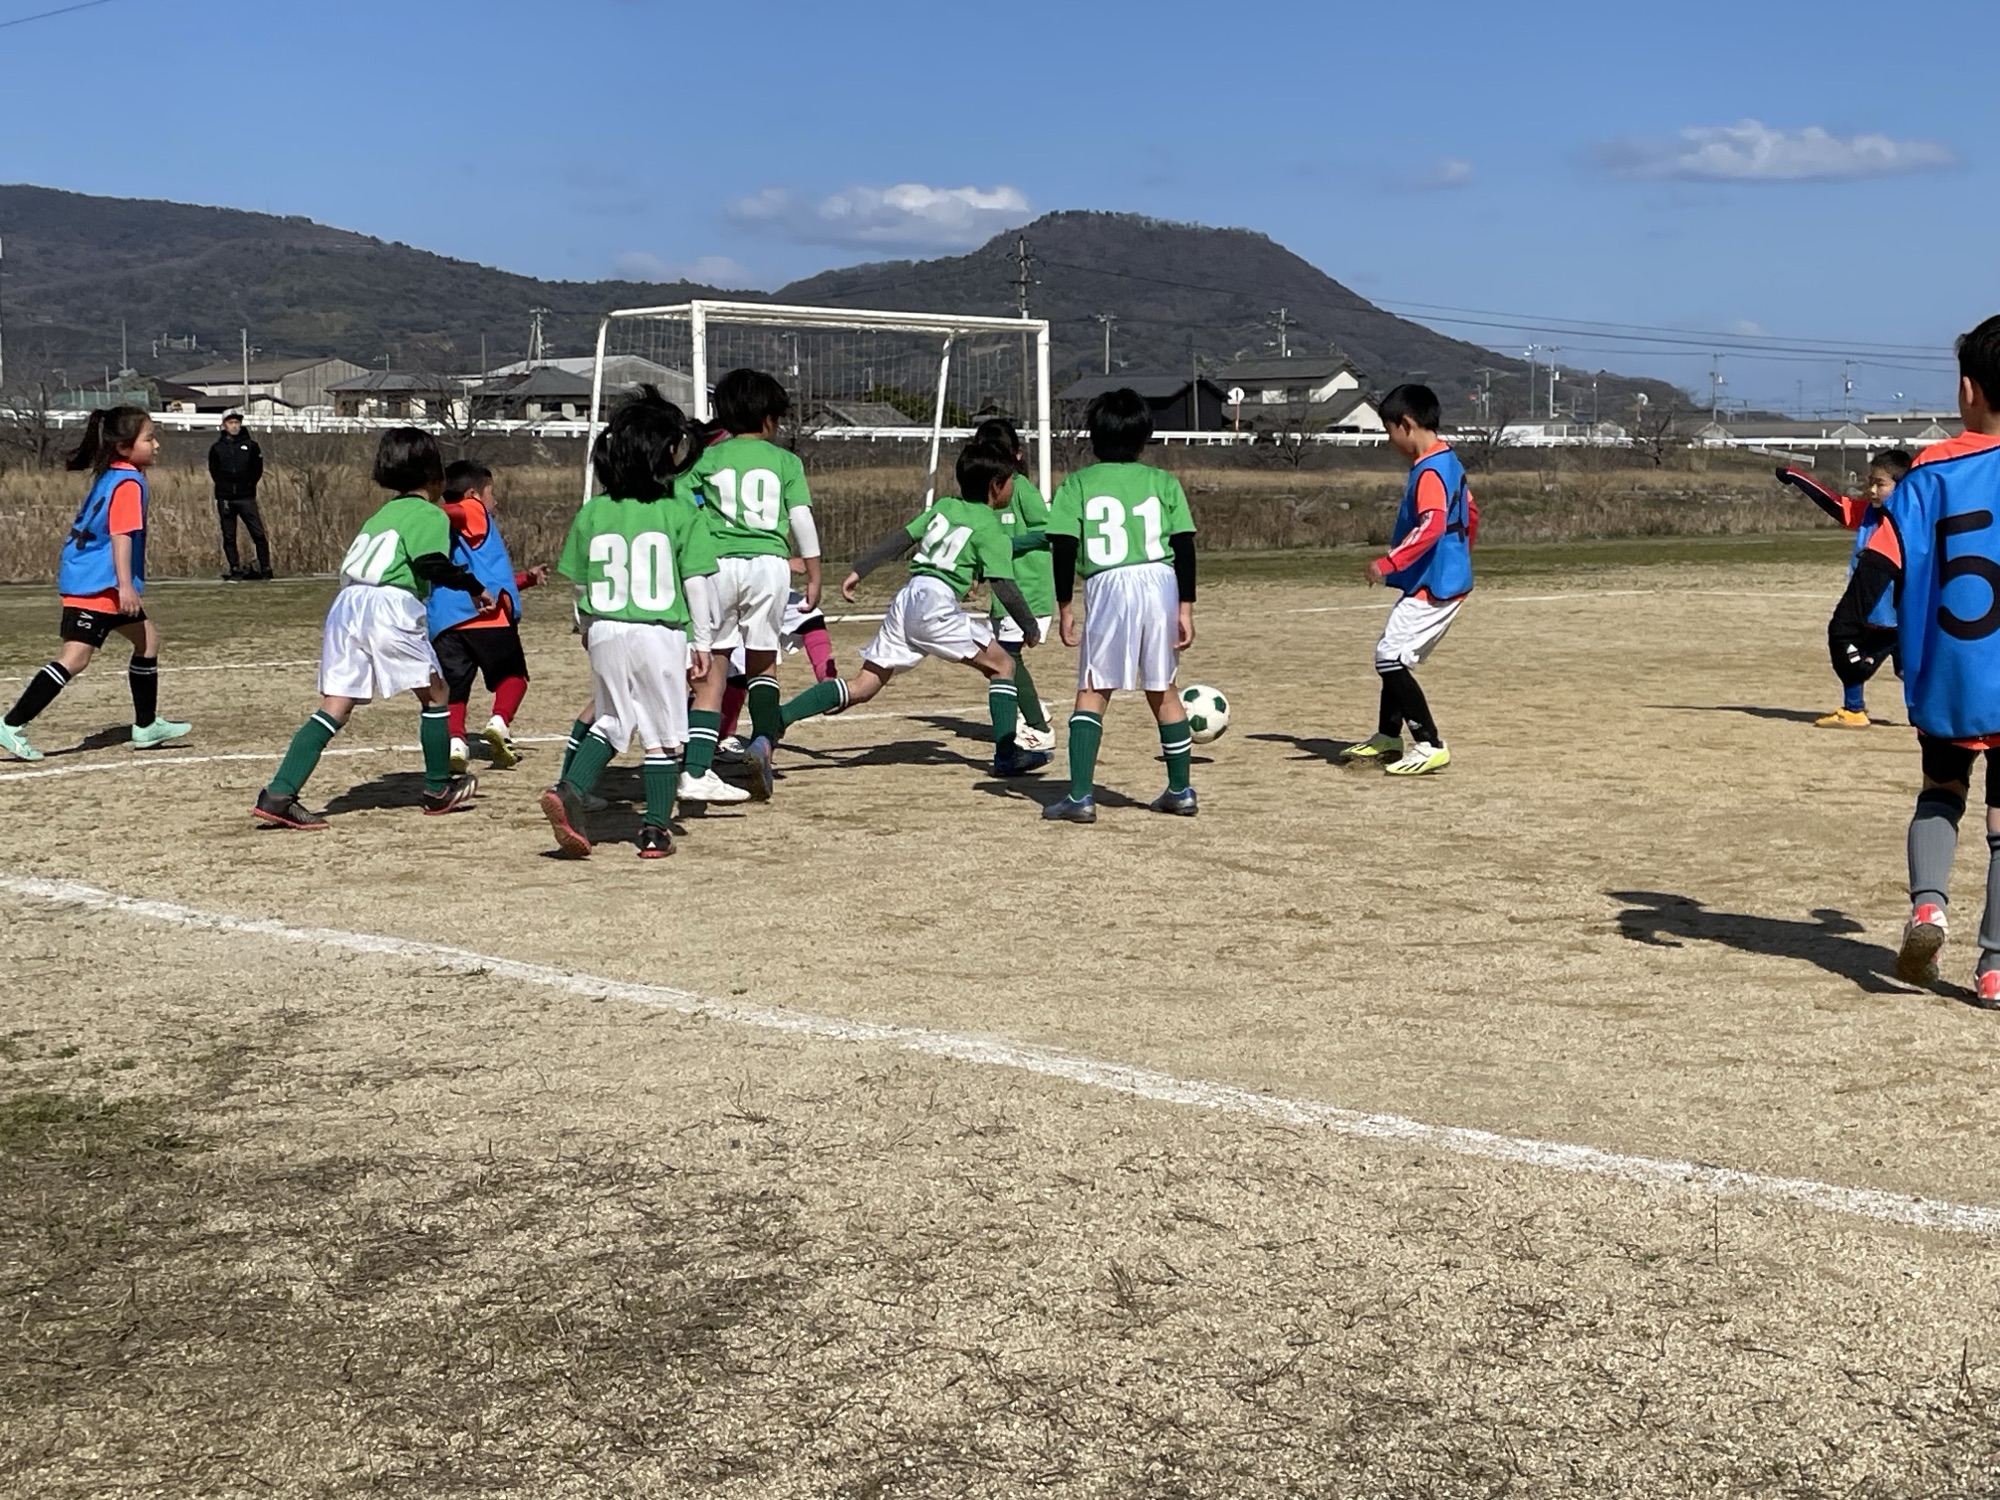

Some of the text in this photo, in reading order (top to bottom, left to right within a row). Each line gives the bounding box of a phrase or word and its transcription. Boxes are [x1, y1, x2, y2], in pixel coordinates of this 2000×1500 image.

[704, 468, 781, 530] 19
[1086, 496, 1165, 566] 31
[589, 531, 676, 612] 30
[913, 512, 974, 572] 24
[1935, 509, 2000, 641] 5
